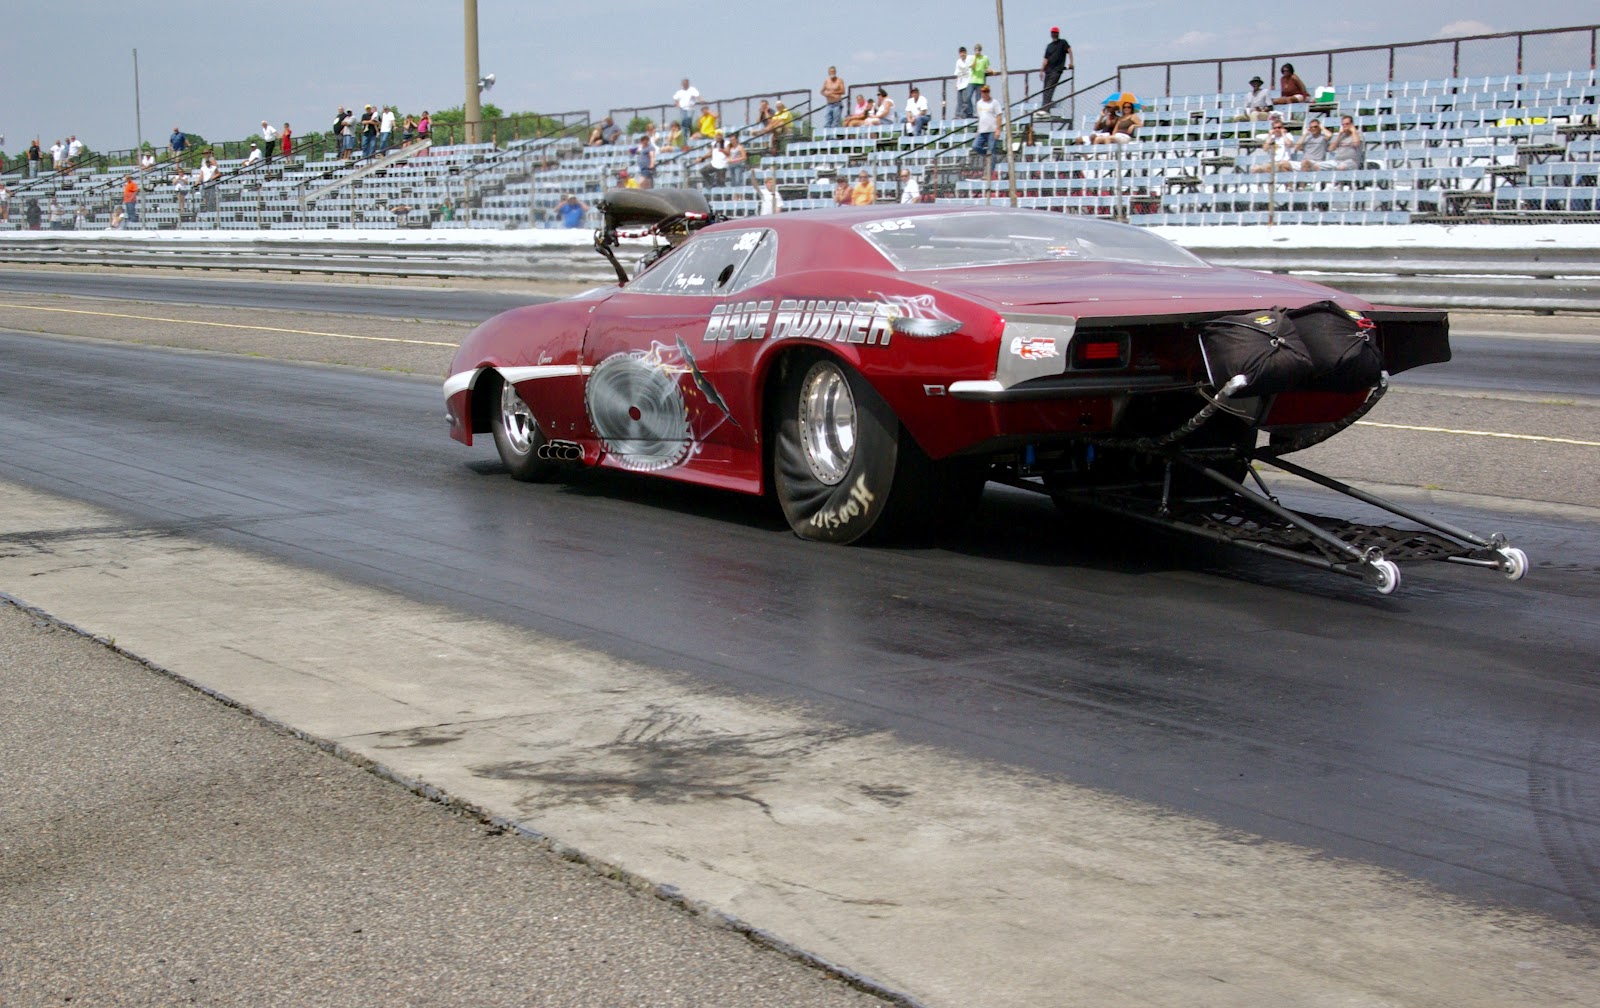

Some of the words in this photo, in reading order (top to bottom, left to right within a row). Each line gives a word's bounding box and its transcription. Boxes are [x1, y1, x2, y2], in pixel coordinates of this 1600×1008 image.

[865, 219, 916, 233] 382
[703, 300, 775, 341] BLADE
[771, 299, 901, 345] RUNNER
